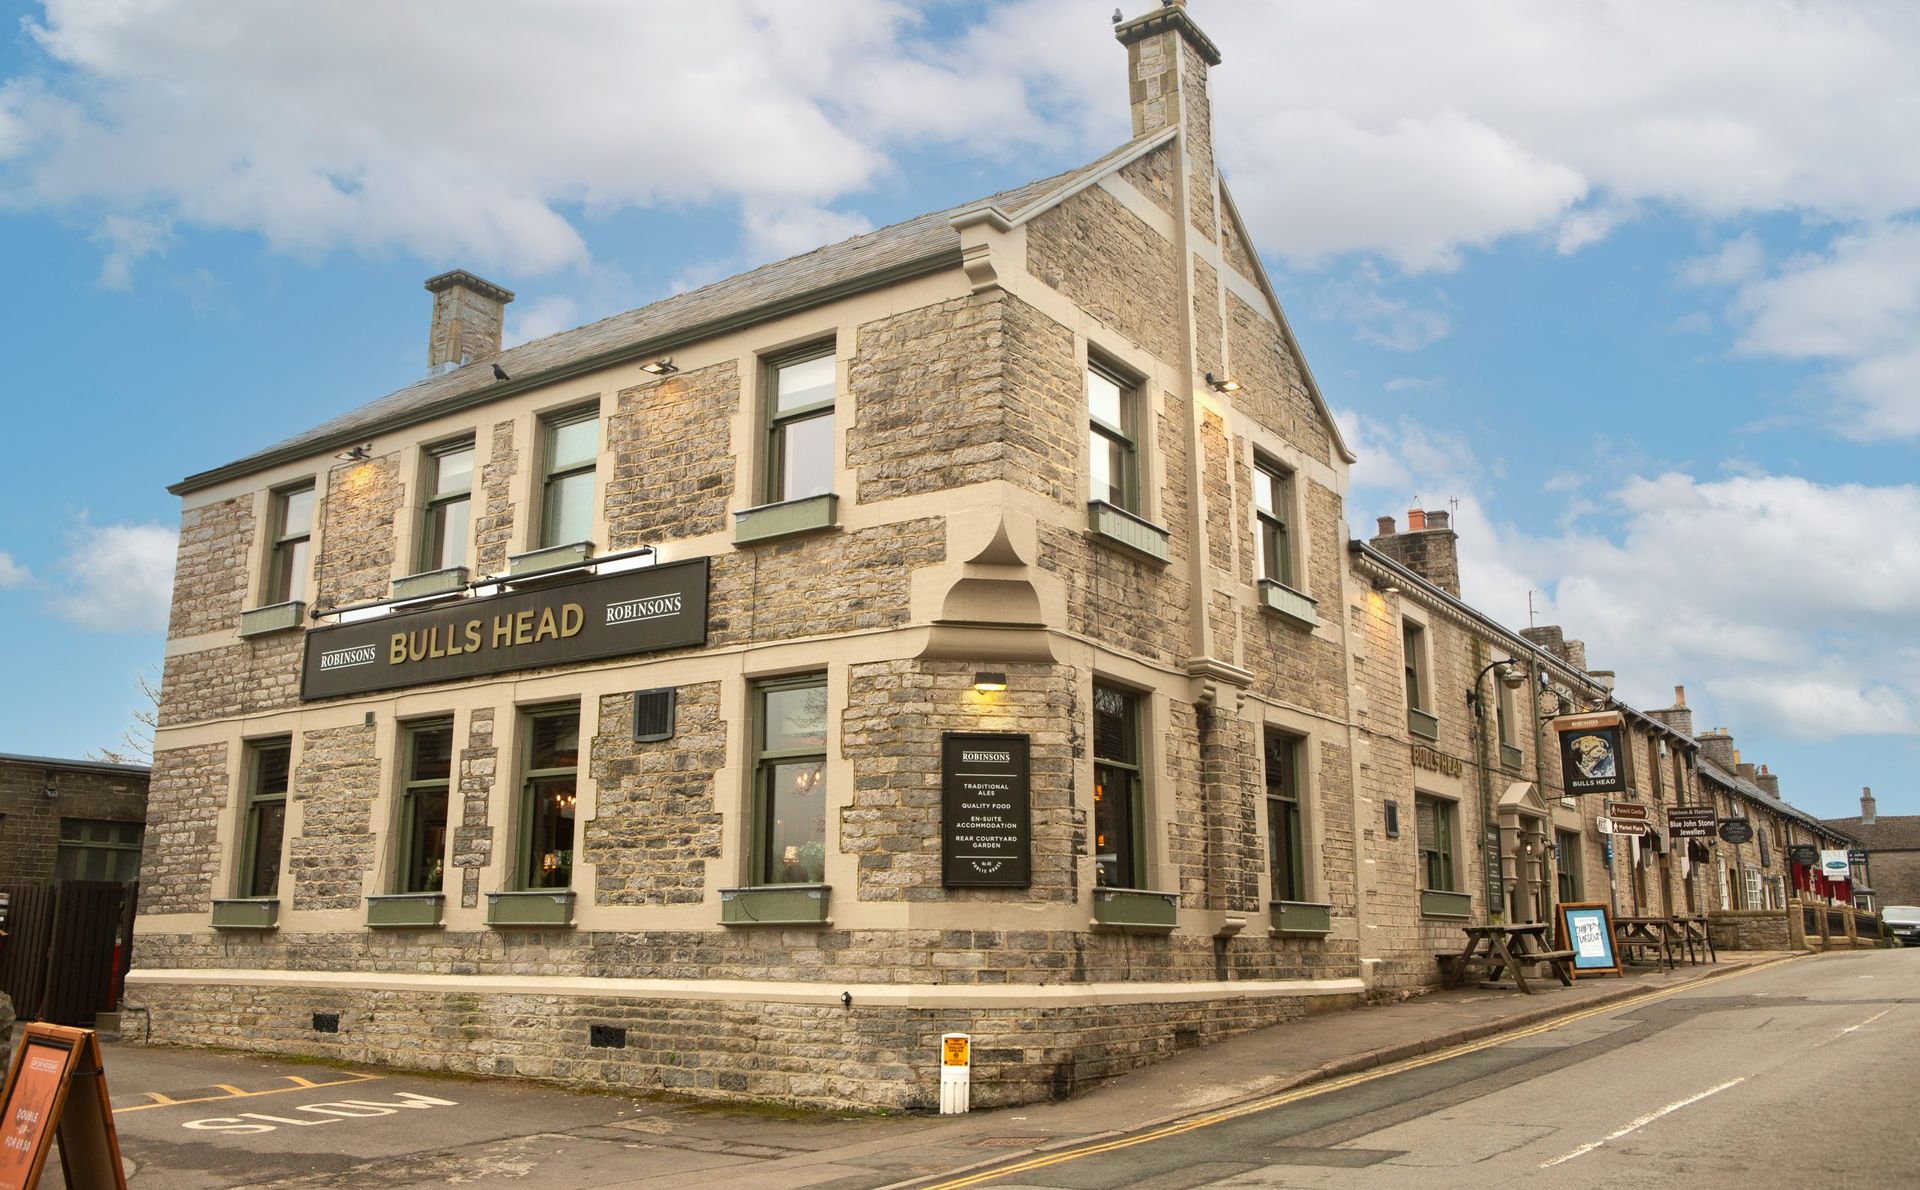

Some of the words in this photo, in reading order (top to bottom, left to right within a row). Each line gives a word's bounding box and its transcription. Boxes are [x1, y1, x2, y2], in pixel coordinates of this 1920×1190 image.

[606, 596, 682, 621] ROBINSONS
[389, 619, 482, 666] BULLS
[492, 603, 585, 649] HEAD
[320, 647, 376, 668] ROBINSONS
[1571, 719, 1598, 727] ROBINSONS
[962, 752, 1010, 761] ROBINSONS
[1411, 746, 1439, 772] BULLS
[1439, 753, 1463, 779] HEAD
[1596, 778, 1616, 786] HEAD
[1670, 820, 1682, 828] Blue
[1683, 820, 1697, 828] John
[1698, 819, 1715, 827] Stone
[1680, 828, 1706, 836] Jewellers
[16, 1108, 39, 1123] DOUBLE
[182, 1092, 460, 1135] SLOW
[5, 1135, 17, 1148] FOR
